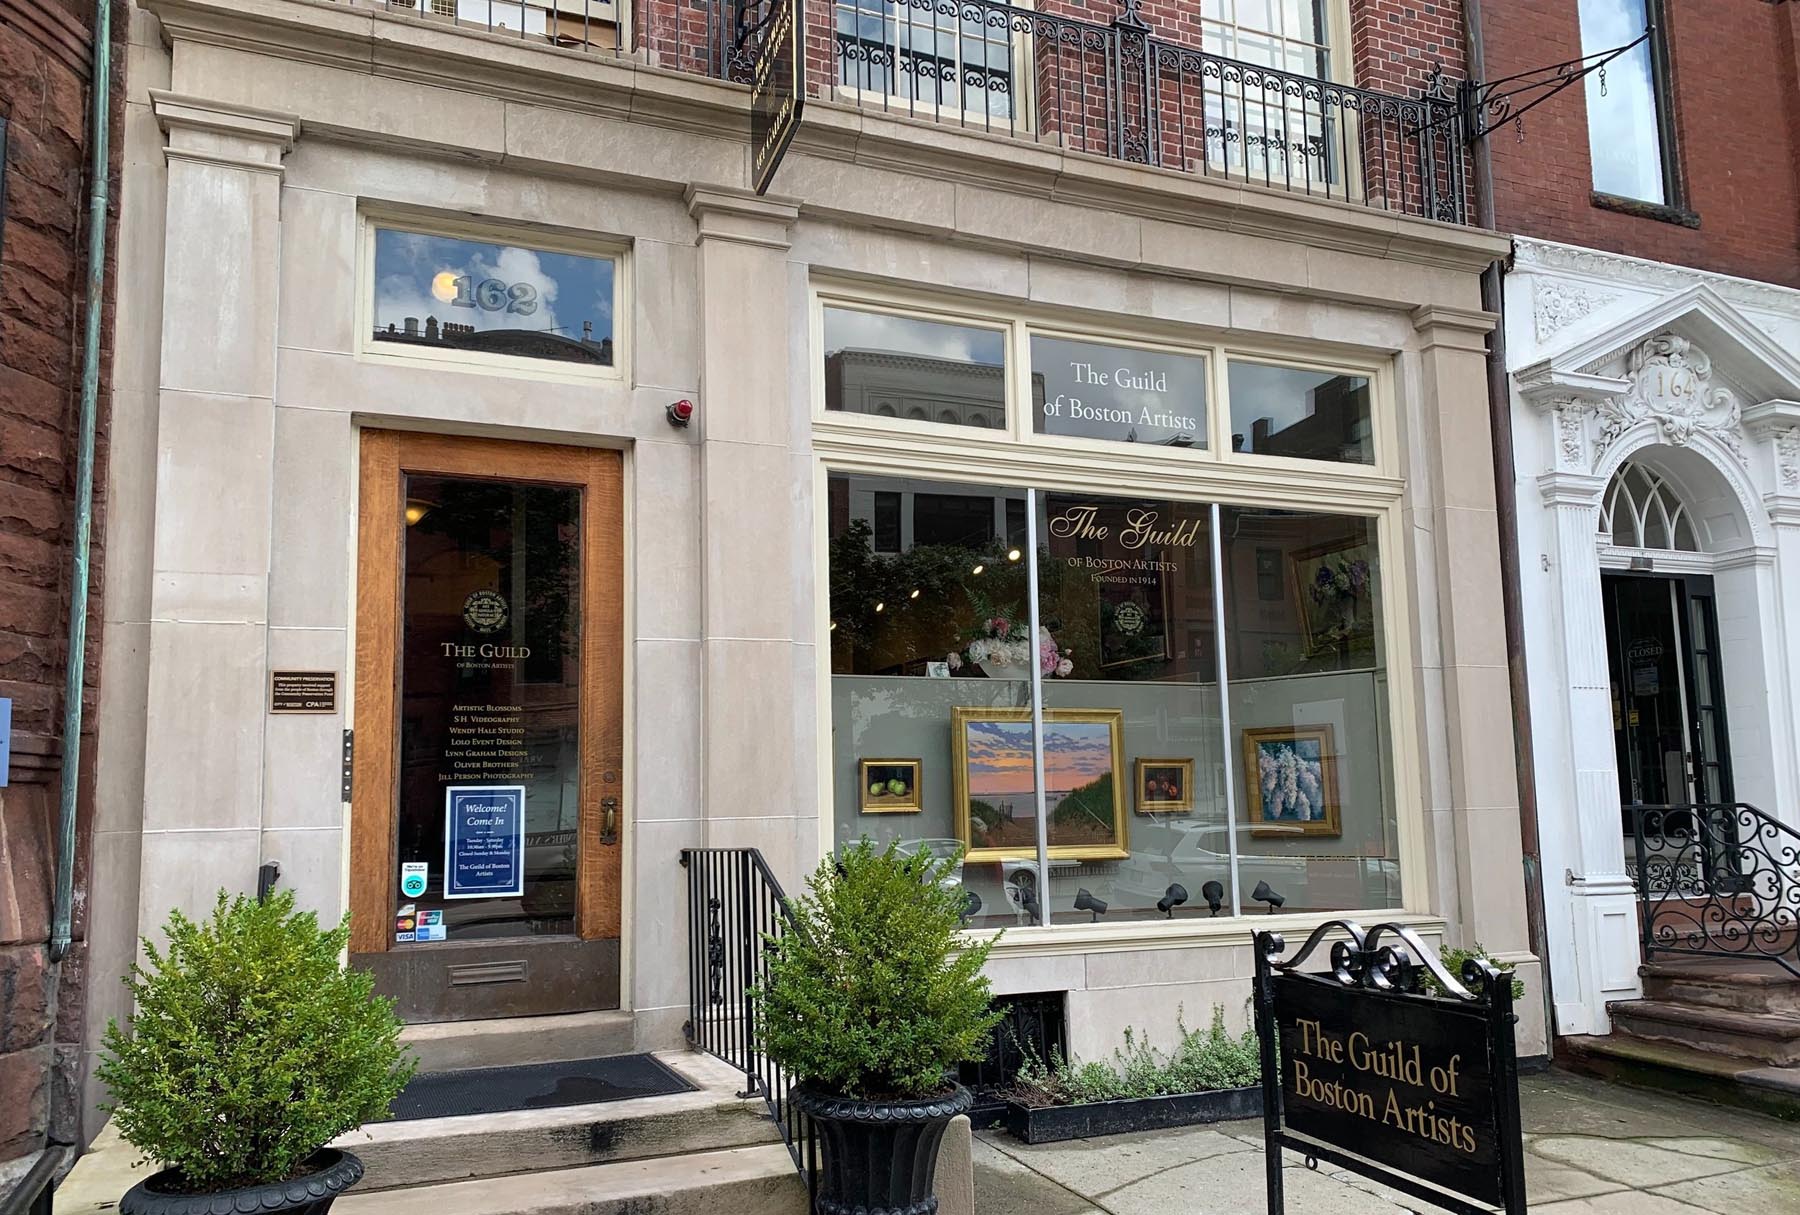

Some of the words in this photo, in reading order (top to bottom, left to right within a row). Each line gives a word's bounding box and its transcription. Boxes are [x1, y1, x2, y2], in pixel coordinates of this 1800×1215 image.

[452, 276, 538, 316] 162
[1070, 362, 1108, 386] The
[1114, 368, 1168, 392] Guild
[1658, 372, 1692, 400] 164
[1044, 394, 1064, 416] of
[1069, 398, 1132, 424] Boston
[1138, 406, 1196, 431] Artists
[1050, 506, 1109, 540] The
[1120, 508, 1201, 549] Guild
[1086, 556, 1132, 570] BOSTON
[1133, 559, 1178, 572] ARTISTS
[1091, 574, 1128, 583] FOUNDED
[1138, 576, 1156, 585] 1914
[441, 642, 476, 657] THE
[480, 643, 530, 658] GUILD
[1629, 646, 1662, 658] CLOSED
[438, 773, 452, 781] JILL
[465, 804, 508, 813] Welcome!
[467, 817, 493, 825] Come
[495, 817, 504, 825] In
[1296, 1017, 1344, 1064] The
[1349, 1032, 1424, 1087] Guild
[1430, 1054, 1460, 1097] of
[1293, 1059, 1376, 1120] Boston
[1382, 1087, 1476, 1153] Artists
